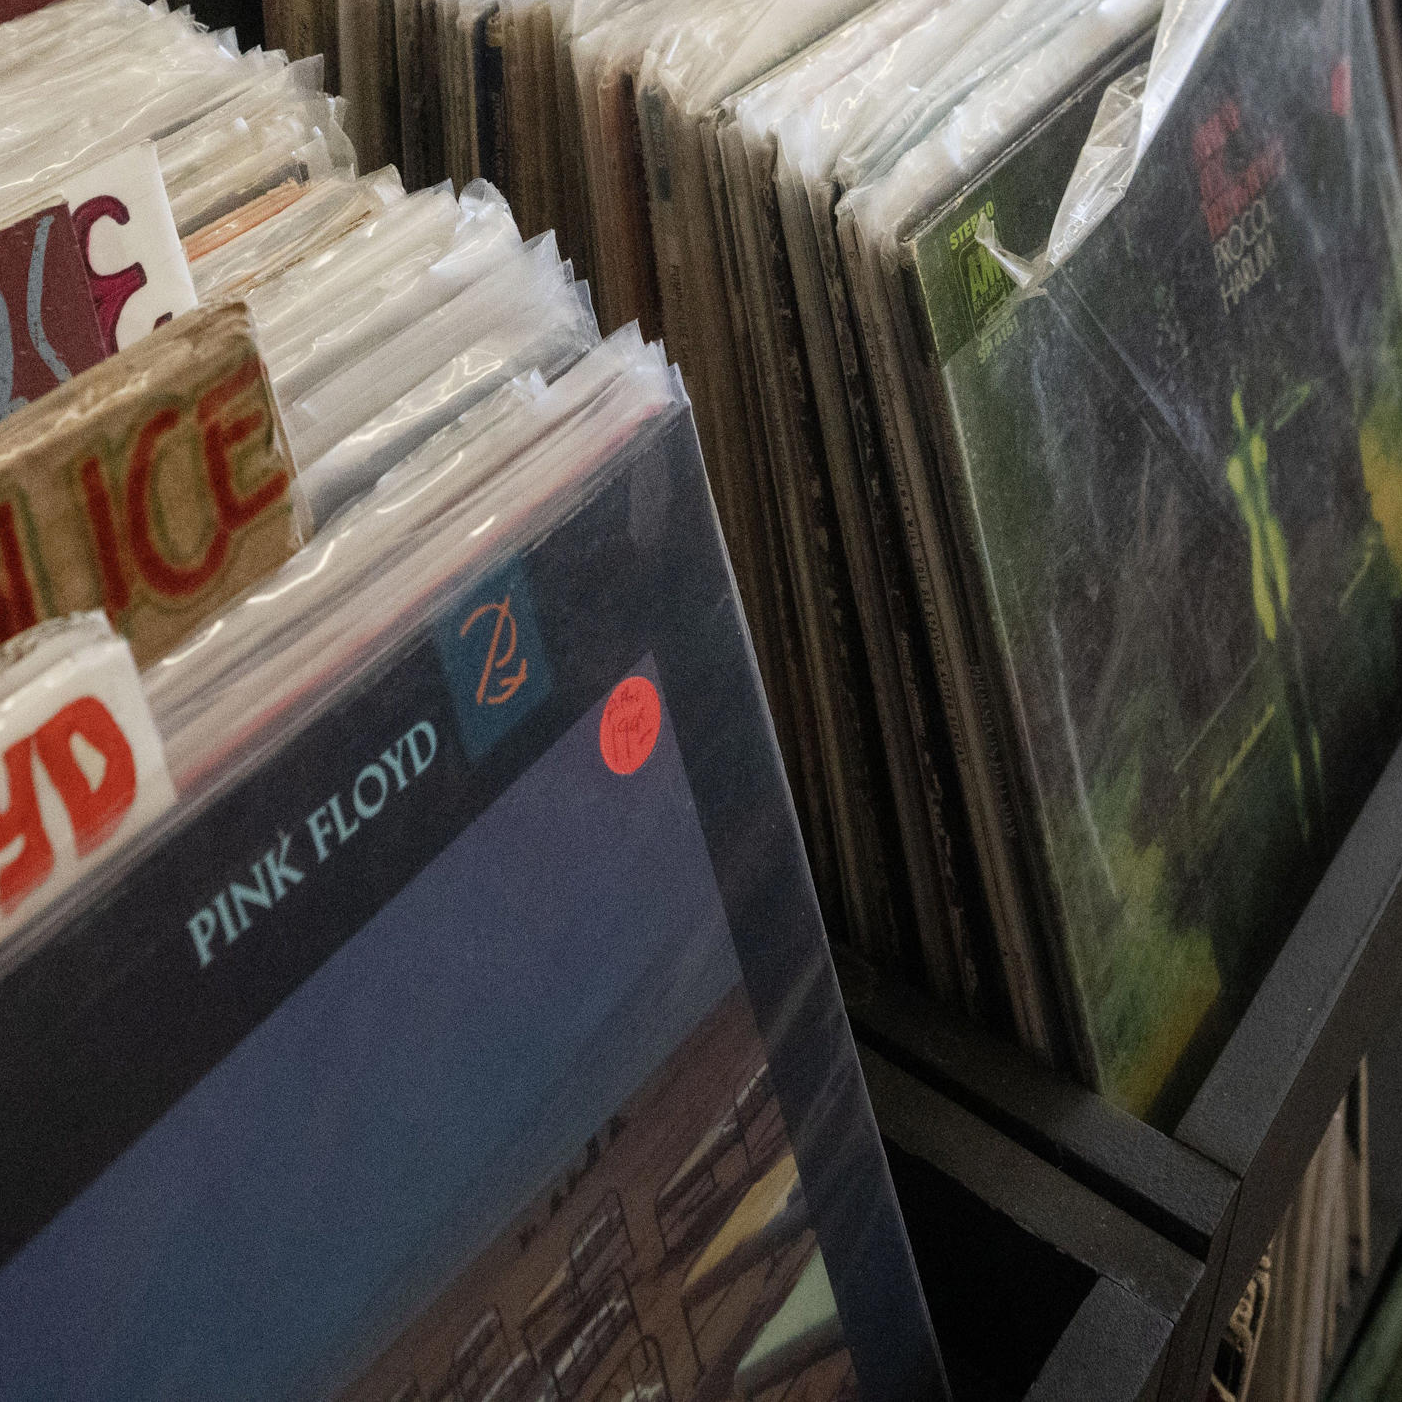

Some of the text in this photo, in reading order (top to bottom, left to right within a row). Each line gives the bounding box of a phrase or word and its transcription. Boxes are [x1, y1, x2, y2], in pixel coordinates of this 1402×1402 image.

[1212, 197, 1272, 278] PROCOL
[1220, 231, 1276, 316] HARUM
[186, 719, 439, 970] PINK FLOYD
